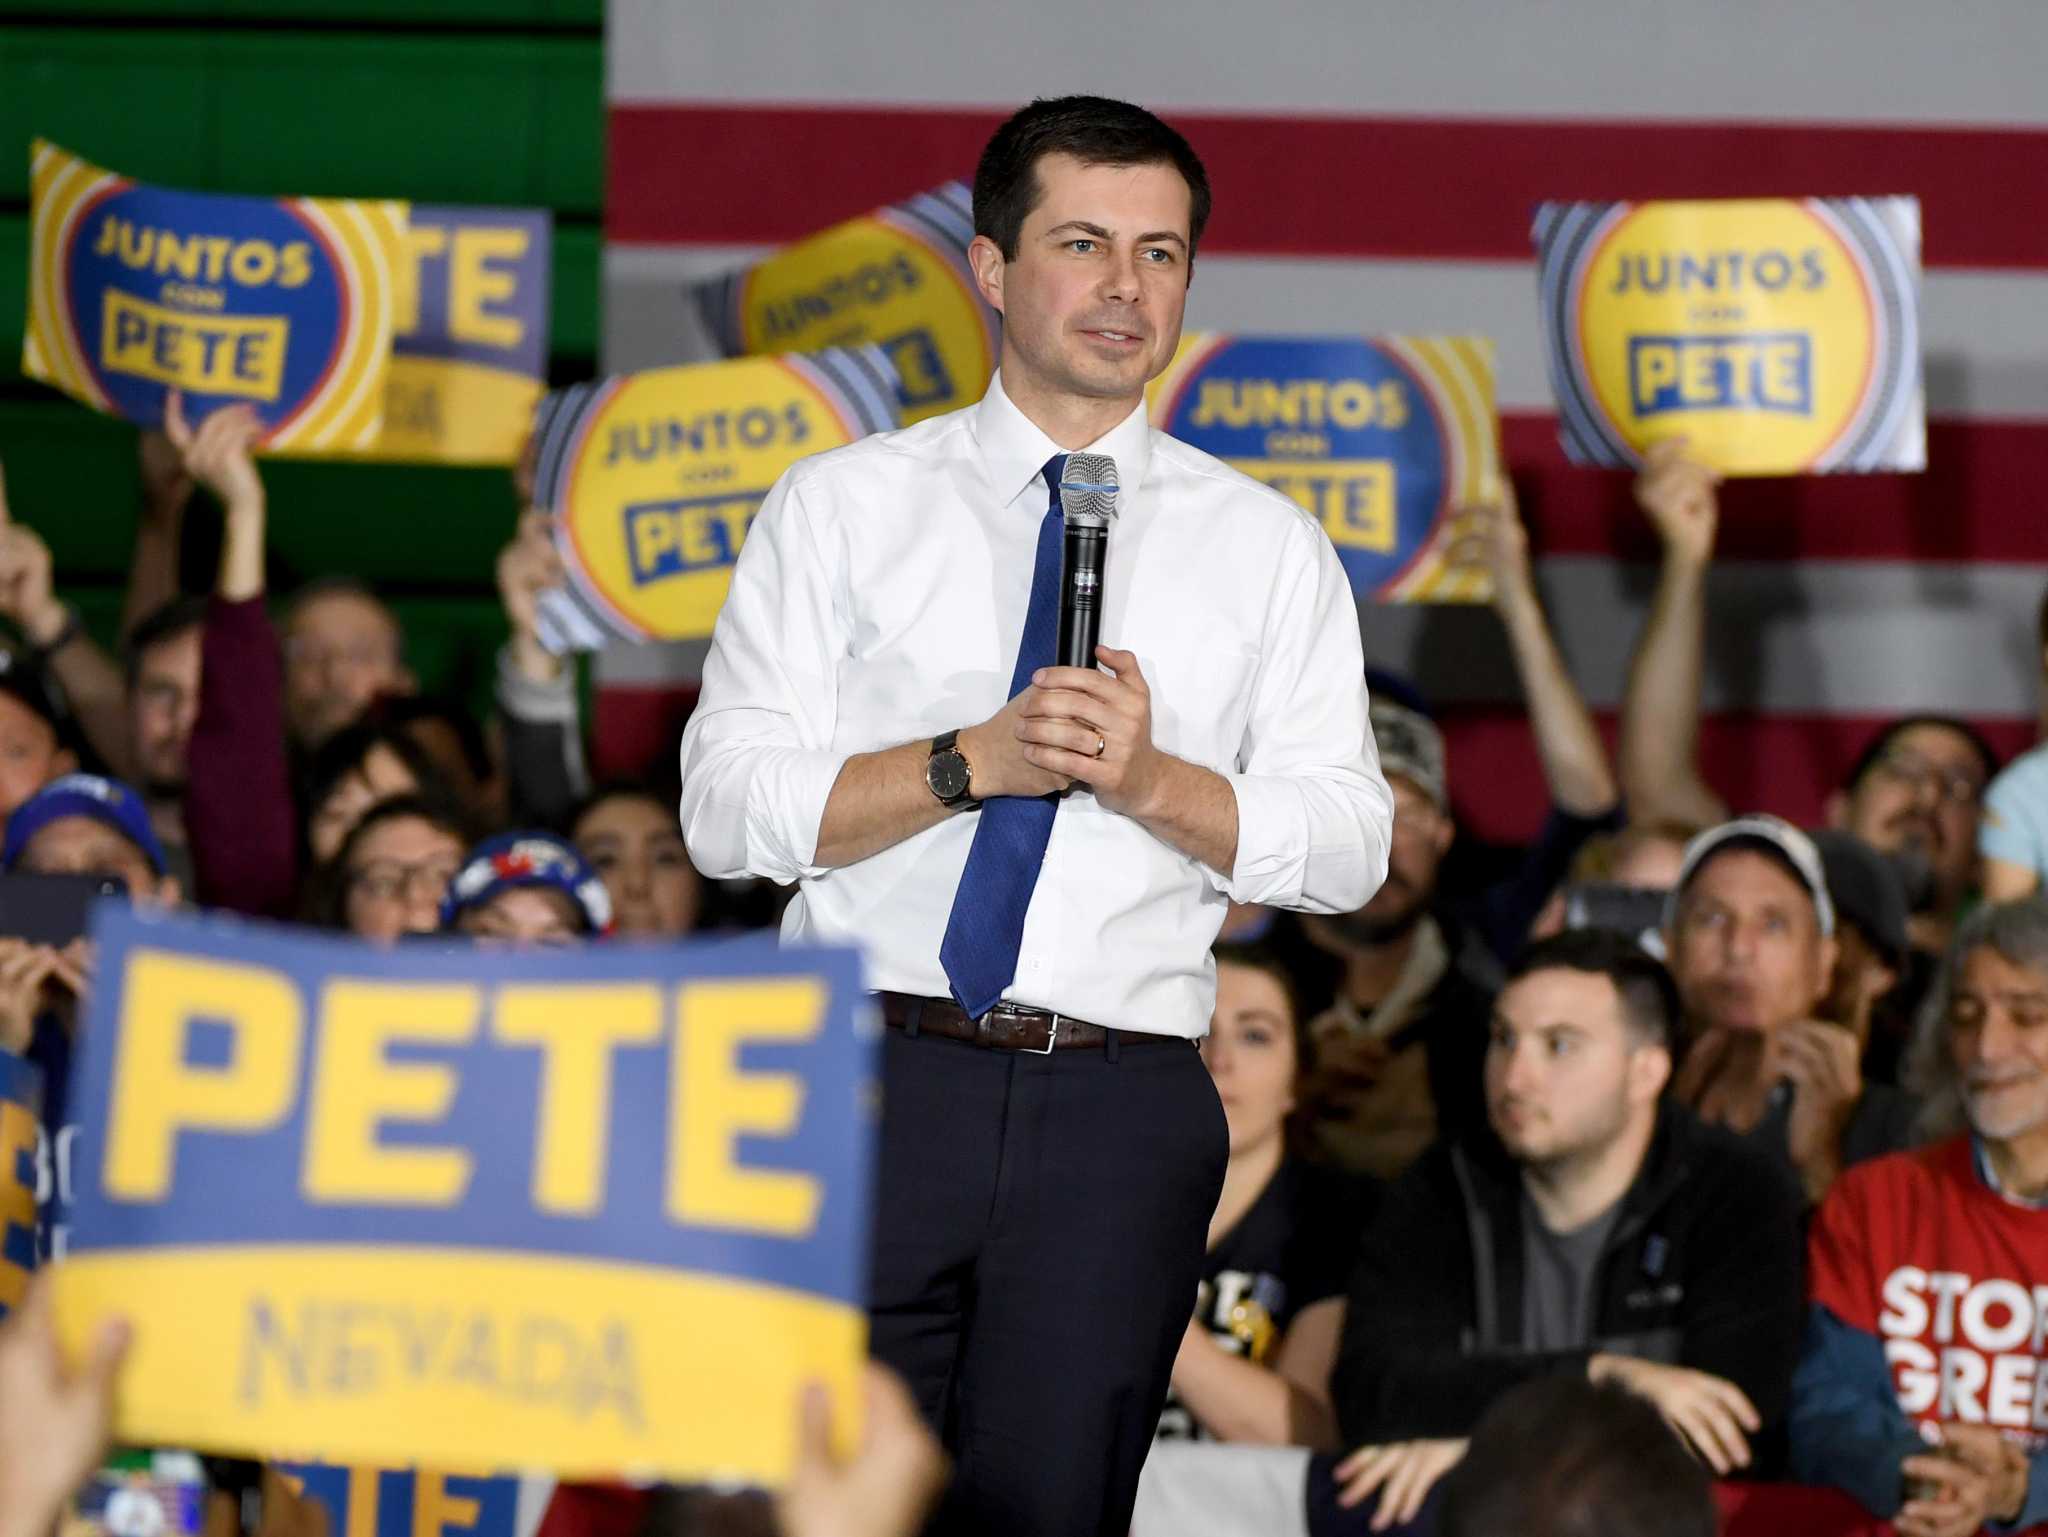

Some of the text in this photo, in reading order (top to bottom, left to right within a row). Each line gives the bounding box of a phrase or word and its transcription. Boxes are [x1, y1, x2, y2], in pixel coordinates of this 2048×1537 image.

[95, 215, 312, 288] JUNTOS
[1612, 250, 1826, 294] JUNTOS
[394, 228, 529, 347] TE
[116, 309, 270, 382] PETE
[1637, 344, 1802, 406] PETE
[604, 402, 810, 465] JUNTOS
[1192, 378, 1408, 428] JUNTOS
[634, 503, 757, 572] PET
[102, 950, 828, 1238] PETE
[236, 1296, 648, 1435] NEVADA
